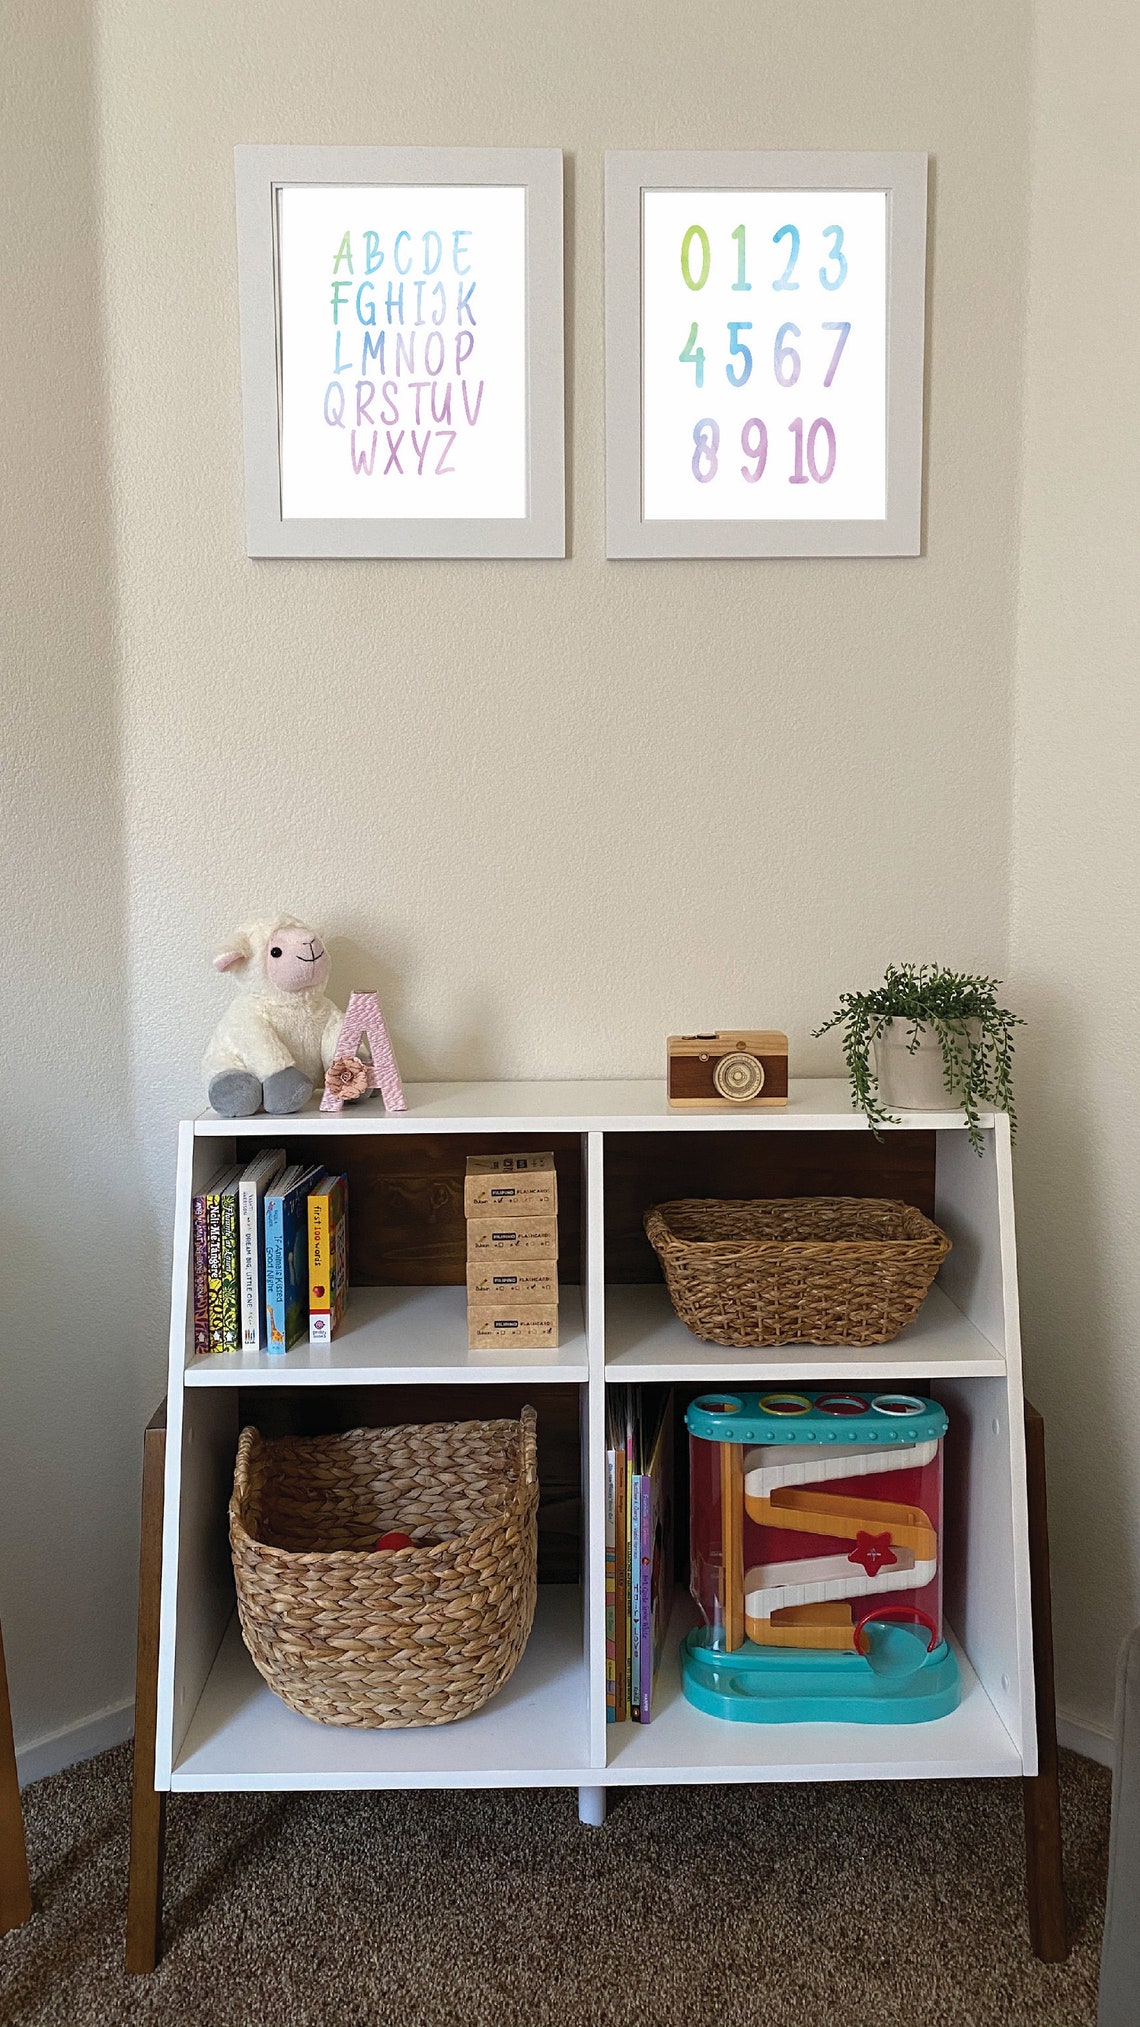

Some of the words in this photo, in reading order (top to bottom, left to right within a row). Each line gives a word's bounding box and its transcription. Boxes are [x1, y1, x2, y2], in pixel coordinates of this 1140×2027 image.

[788, 417, 836, 484] 10
[319, 990, 408, 1112] A
[313, 1206, 322, 1224] first
[266, 1247, 274, 1268] Good
[275, 1244, 283, 1275] Animals
[266, 1269, 275, 1292] Night
[275, 1277, 284, 1302] Kissed
